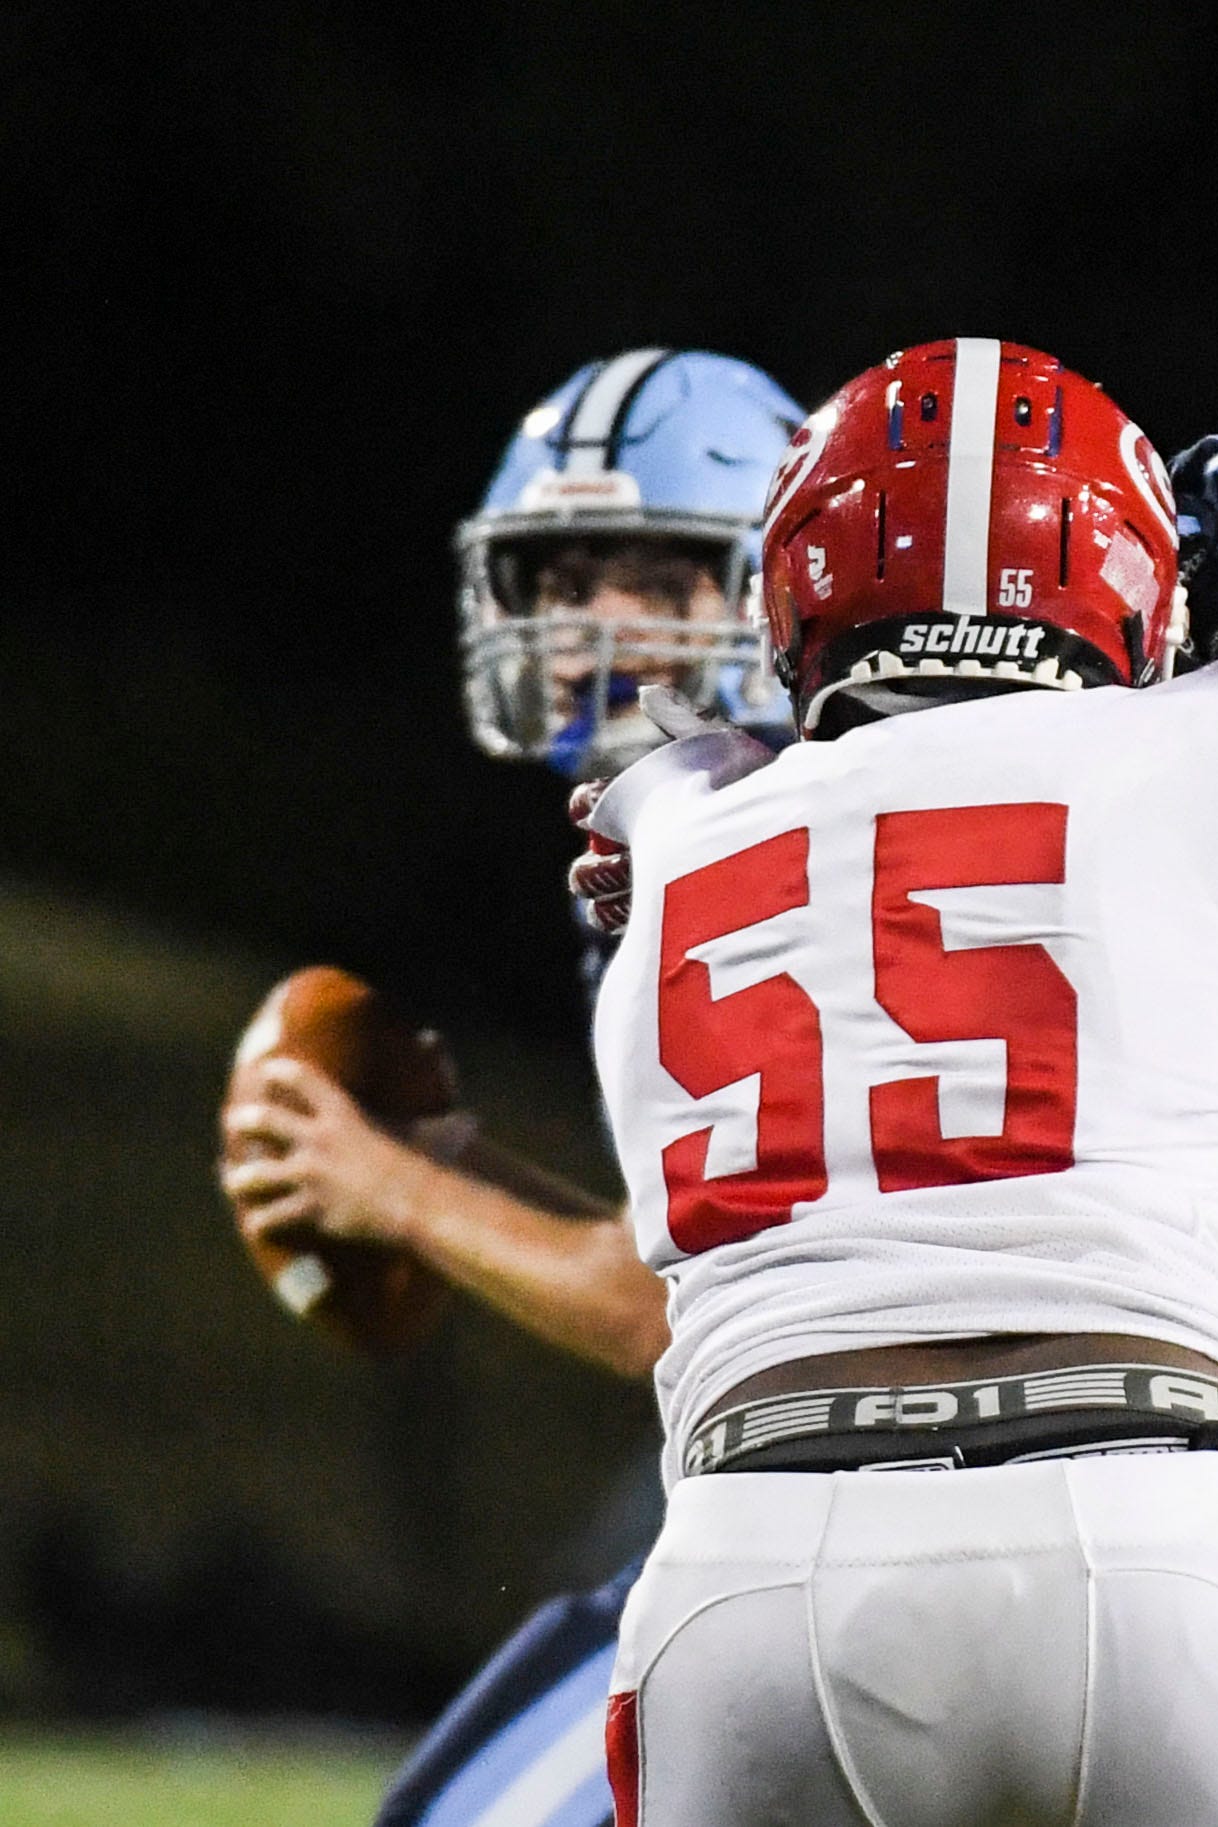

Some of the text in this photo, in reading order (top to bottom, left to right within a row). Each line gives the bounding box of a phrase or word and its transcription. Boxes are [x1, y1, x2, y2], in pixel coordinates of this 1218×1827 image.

[1000, 568, 1034, 608] 55
[899, 614, 1046, 659] schutt
[658, 801, 1078, 1255] 55
